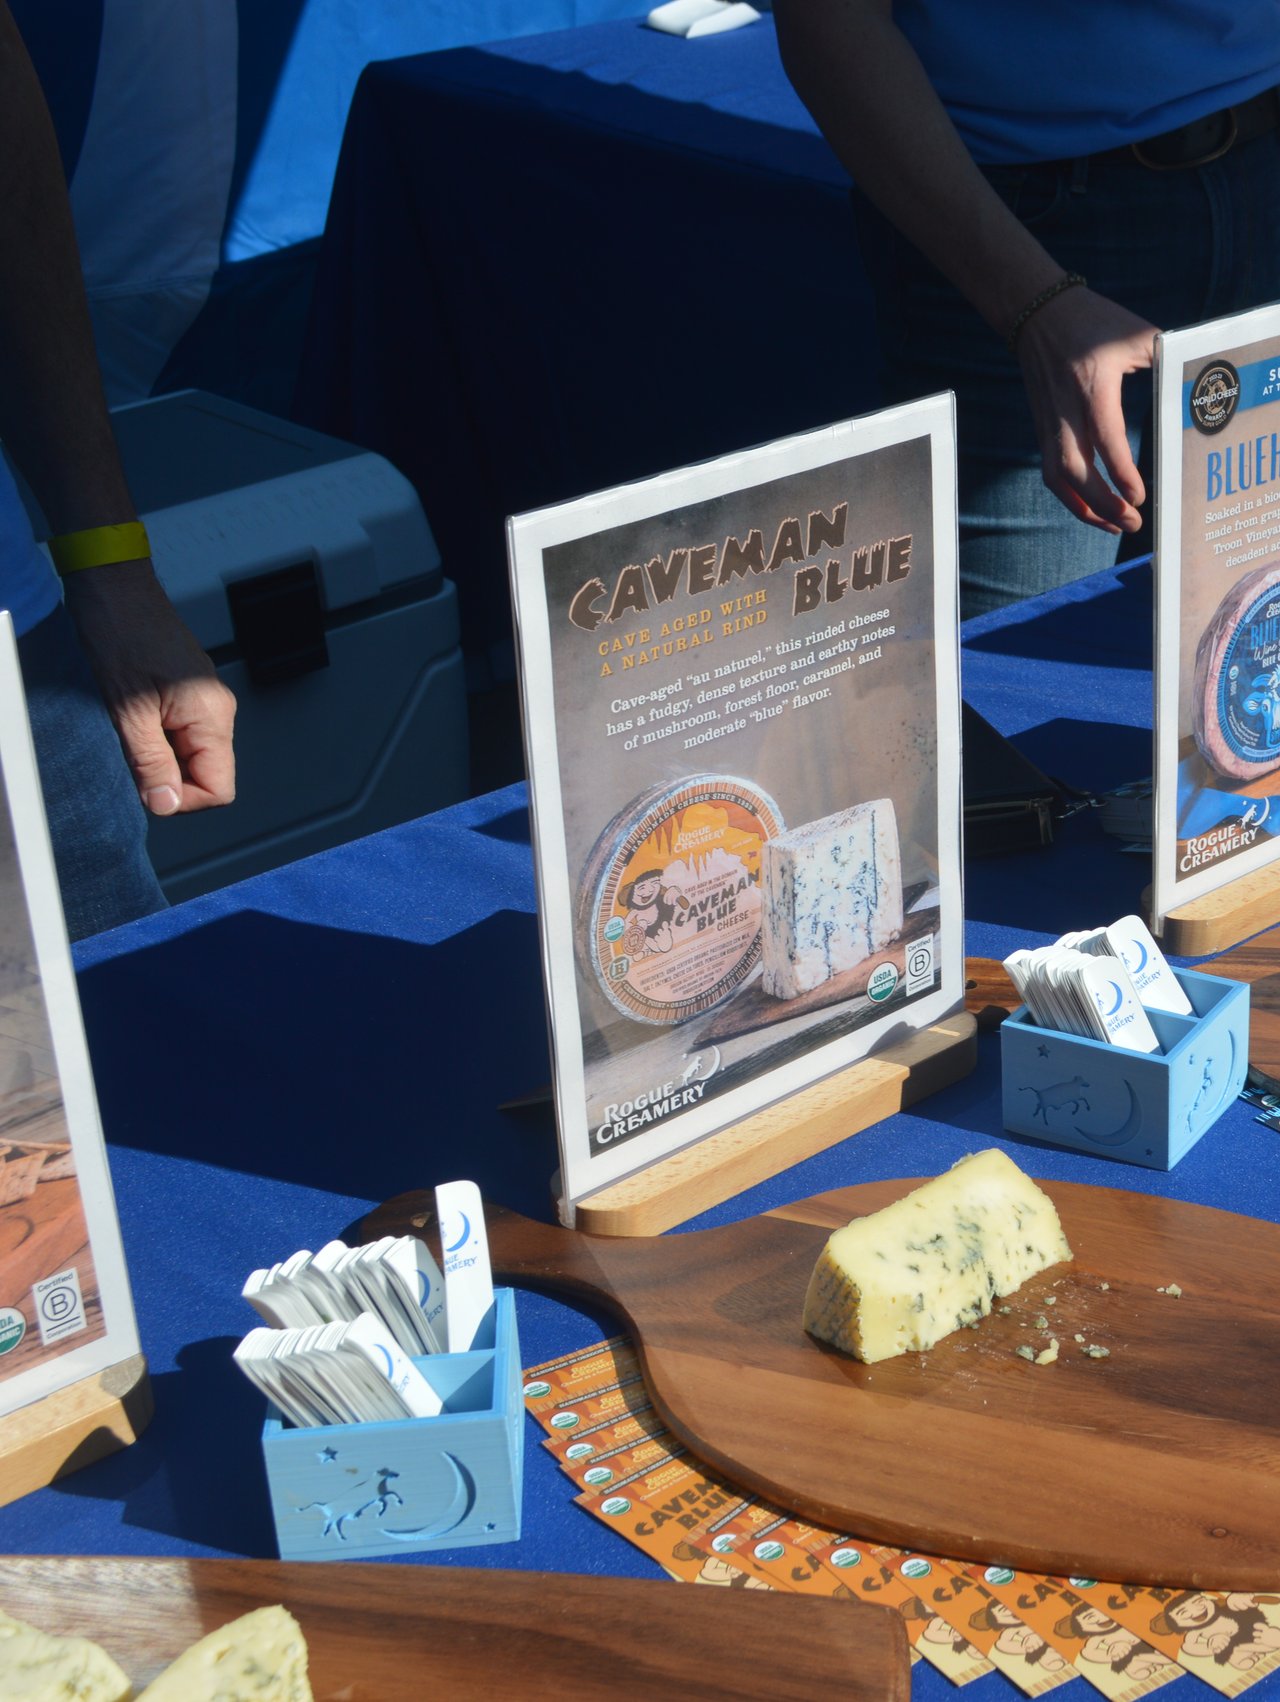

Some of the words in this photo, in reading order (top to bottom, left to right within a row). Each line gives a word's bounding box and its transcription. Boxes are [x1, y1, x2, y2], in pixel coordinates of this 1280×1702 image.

[1192, 393, 1217, 407] WORLD
[1216, 385, 1239, 400] CHEESE
[1262, 385, 1273, 396] AT
[1205, 504, 1242, 525] Soaked
[1243, 499, 1254, 511] in
[1256, 498, 1263, 508] a
[1205, 525, 1232, 541] made
[1234, 518, 1259, 533] from
[1213, 537, 1243, 556] Troon
[1225, 546, 1269, 567] decadent
[568, 501, 848, 631] CAVEMAN
[792, 534, 913, 617] BLUE
[598, 628, 651, 657] CAVE
[659, 608, 712, 638] AGED
[720, 589, 768, 617] WITH
[600, 662, 613, 677] A
[622, 629, 714, 671] NATURAL
[722, 609, 769, 637] RIND
[1253, 641, 1277, 662] Wine
[610, 679, 683, 715] Cave-aged
[775, 637, 802, 656] this
[805, 621, 846, 648] rinded
[848, 608, 890, 630] cheese
[1262, 655, 1276, 668] BLUE
[606, 717, 633, 737] has
[636, 715, 646, 726] a
[648, 697, 694, 724] fudgy,
[697, 679, 736, 704] dense
[739, 661, 787, 689] texture
[789, 652, 816, 673] and
[818, 637, 858, 663] earthy
[861, 624, 896, 646] notes
[623, 732, 640, 751] of
[642, 709, 721, 745] mushroom,
[725, 691, 763, 717] forest
[765, 678, 799, 702] floor,
[802, 657, 856, 686] caramel,
[858, 646, 882, 668] and
[683, 717, 747, 750] moderate
[792, 686, 832, 711] flavor.
[632, 807, 676, 853] HANDMADE
[677, 793, 710, 810] CHEESE
[712, 792, 735, 802] SINCE
[678, 825, 711, 843] ROGUE
[673, 828, 726, 853] CREAMERY
[1180, 826, 1258, 873] CREAMERY
[1187, 823, 1236, 855] ROGUE
[675, 868, 760, 928] CAVEMAN
[696, 898, 737, 932] BLUE
[716, 909, 750, 932] CHEESE
[907, 938, 931, 952] Certified
[873, 969, 892, 984] USDA
[914, 954, 925, 973] B
[596, 1081, 707, 1145] CREAMERY
[603, 1081, 676, 1123] ROGUE
[37, 1271, 74, 1293] Certified
[50, 1292, 69, 1316] B
[530, 1362, 568, 1378] HANDMADE
[559, 1392, 597, 1408] HANDMADE
[603, 1473, 640, 1495] HANDMADE
[635, 1481, 715, 1536] CAVEM
[676, 1490, 732, 1529] BLU
